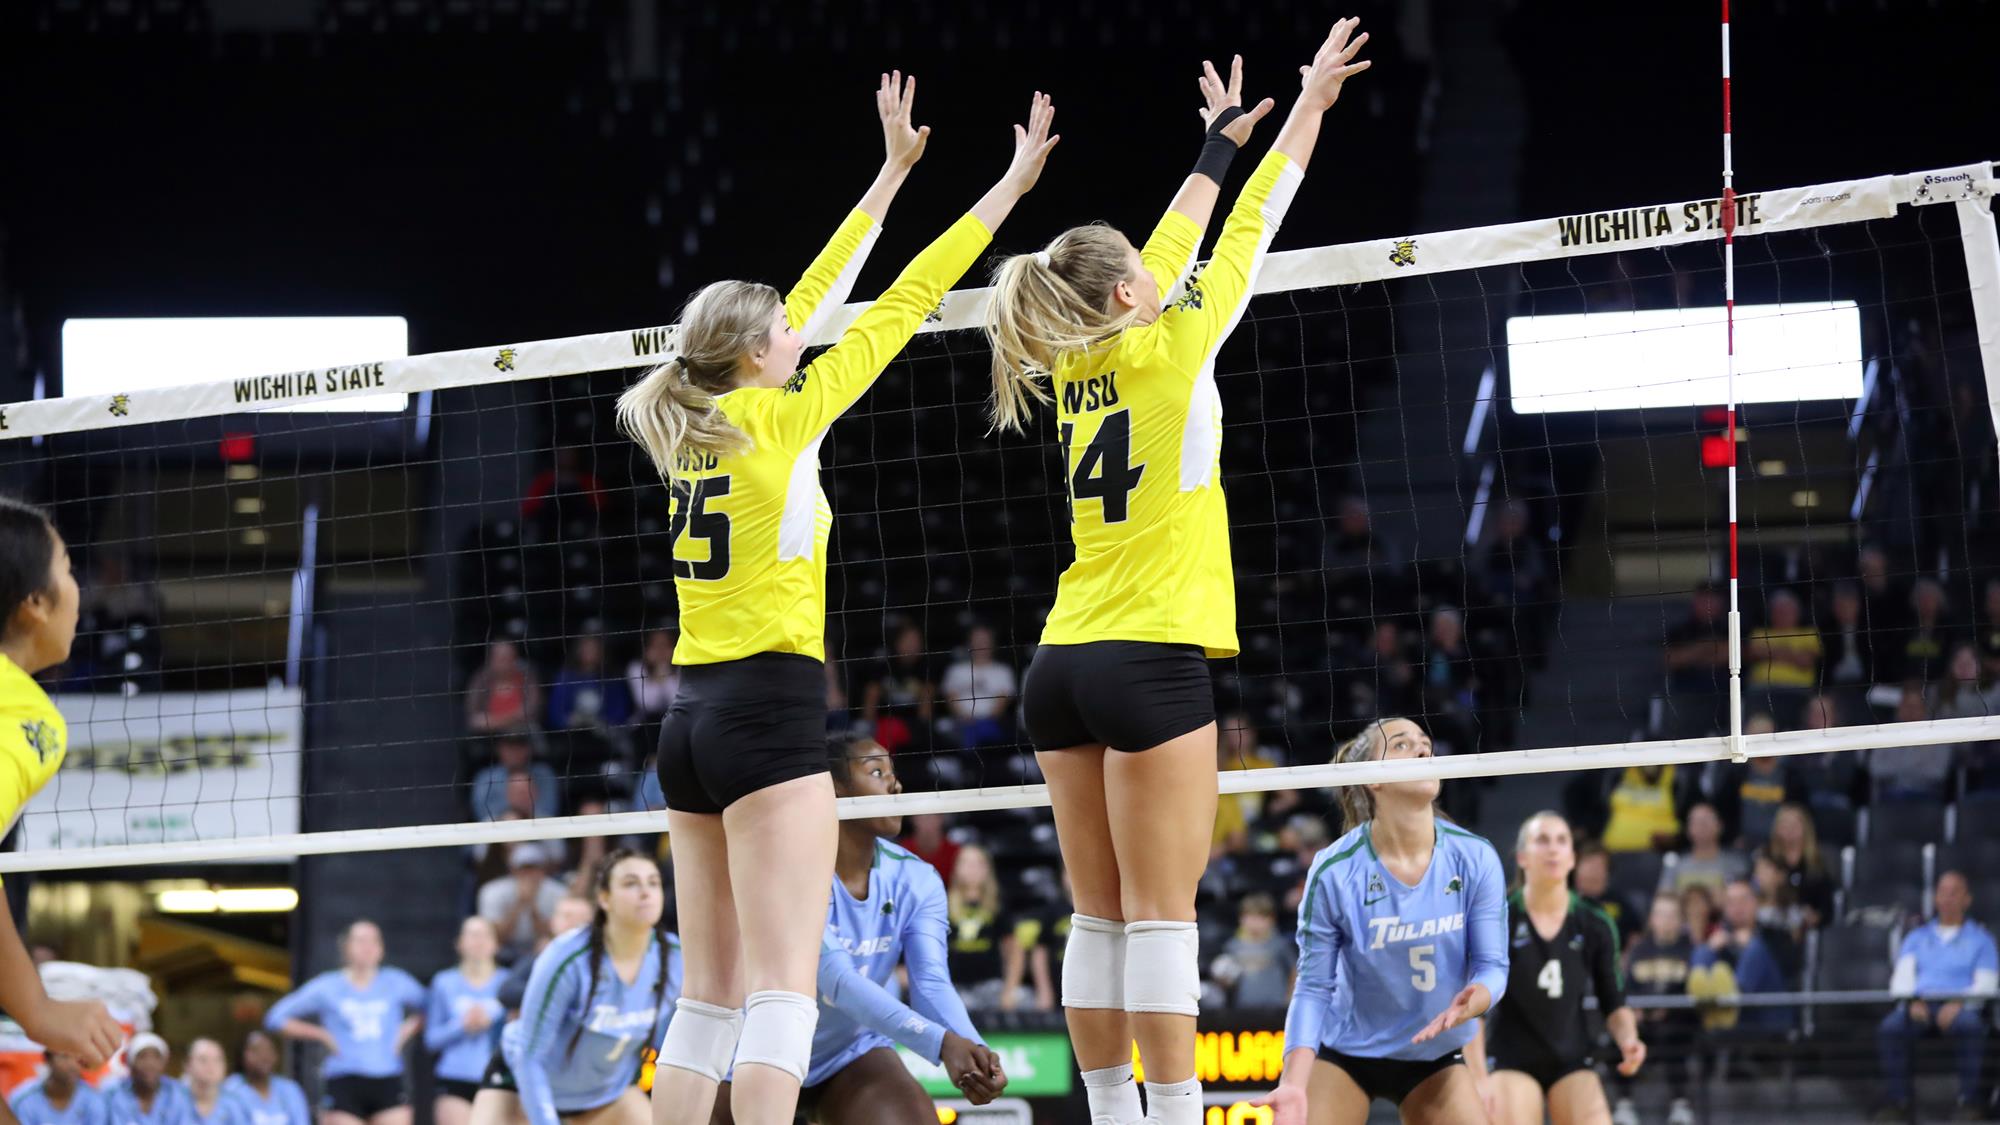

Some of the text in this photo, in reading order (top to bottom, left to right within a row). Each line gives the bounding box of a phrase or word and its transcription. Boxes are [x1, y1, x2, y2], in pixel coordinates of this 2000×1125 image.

[1934, 173, 1970, 184] Senoh
[1558, 194, 1761, 247] WICHITA STTE
[234, 361, 384, 403] WICHITA STATE
[1060, 408, 1146, 524] 14
[670, 474, 731, 580] 25
[1368, 912, 1464, 949] TULANE
[1408, 944, 1437, 992] 5
[1537, 958, 1564, 999] 4
